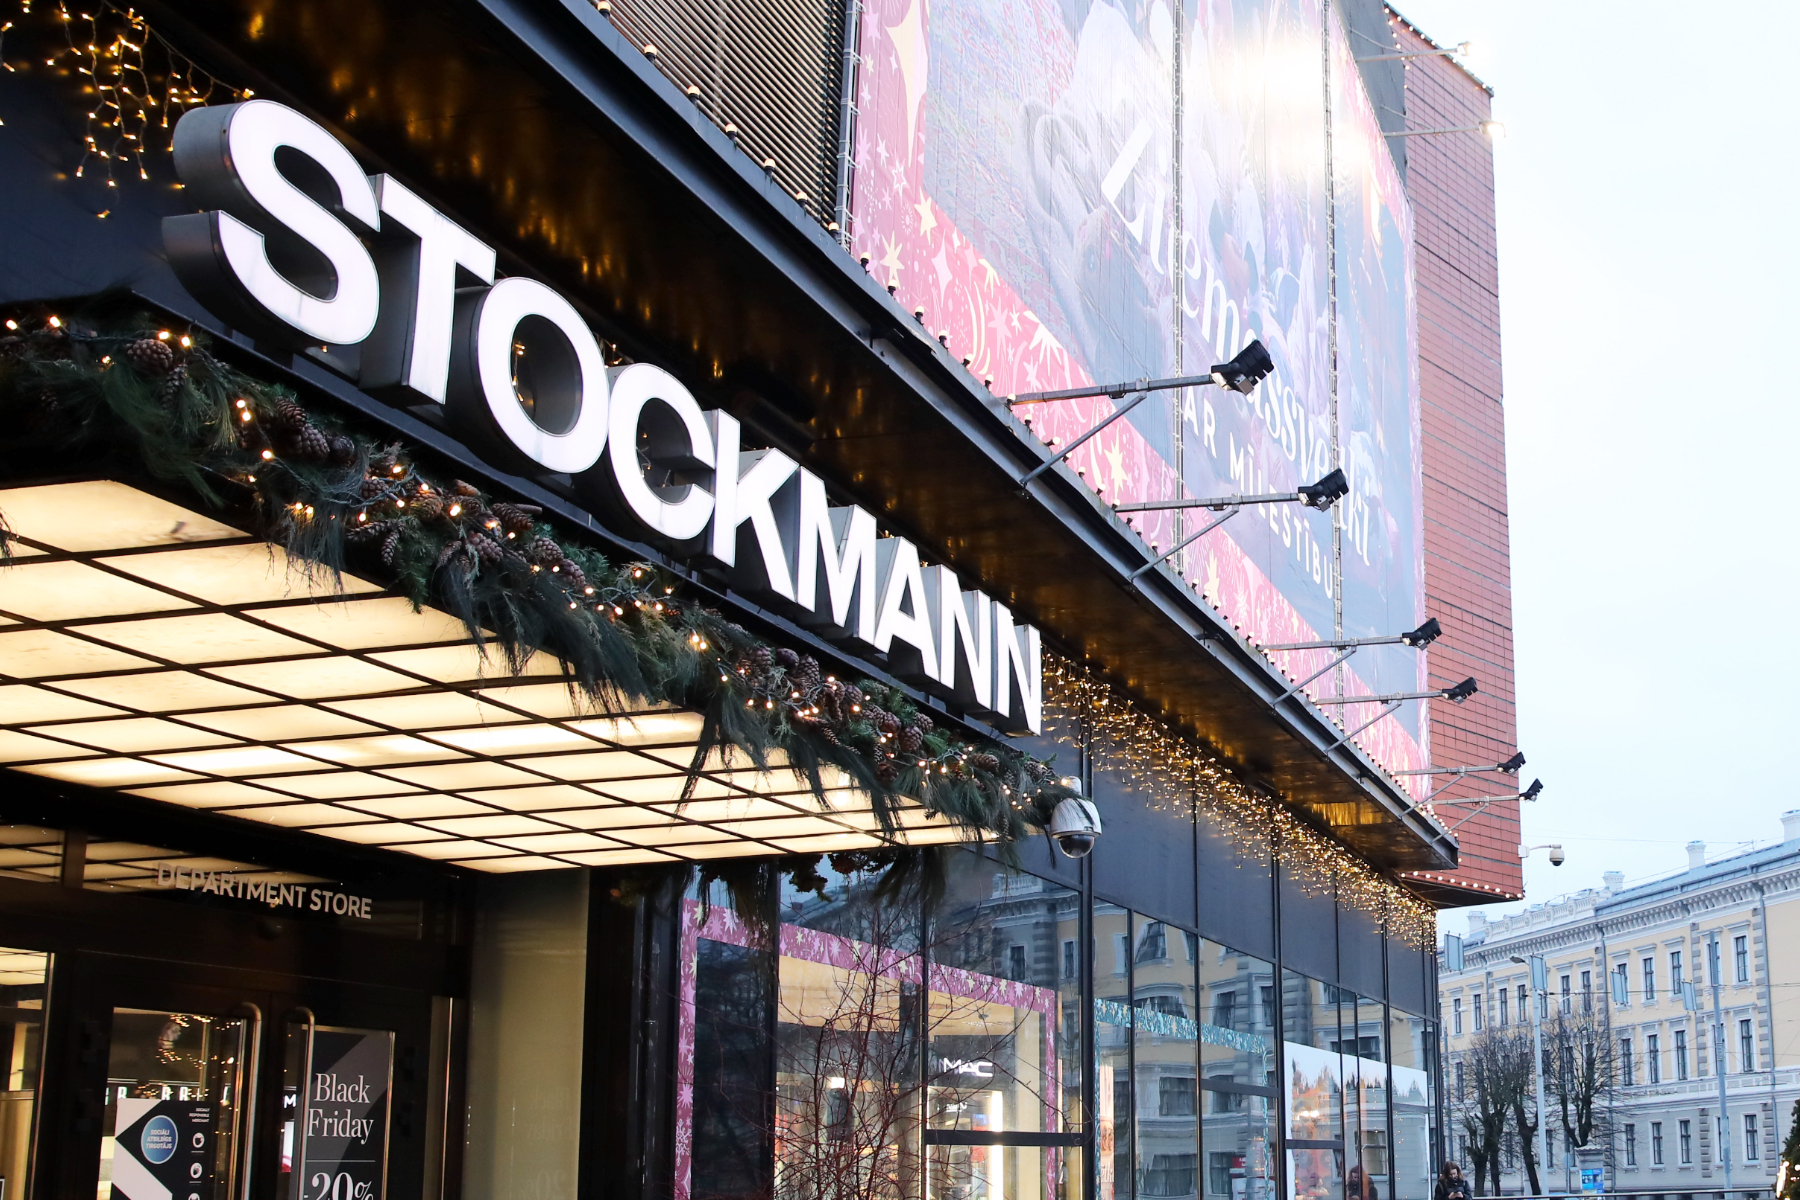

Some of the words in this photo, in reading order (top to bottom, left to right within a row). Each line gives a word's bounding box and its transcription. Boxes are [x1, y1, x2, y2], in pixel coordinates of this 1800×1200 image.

[218, 99, 1042, 737] STOCKMANN
[1184, 386, 1217, 459] AR
[156, 862, 307, 909] DEPARTMENT
[310, 888, 373, 920] STORE
[314, 1073, 371, 1104] Black
[308, 1108, 374, 1145] Friday
